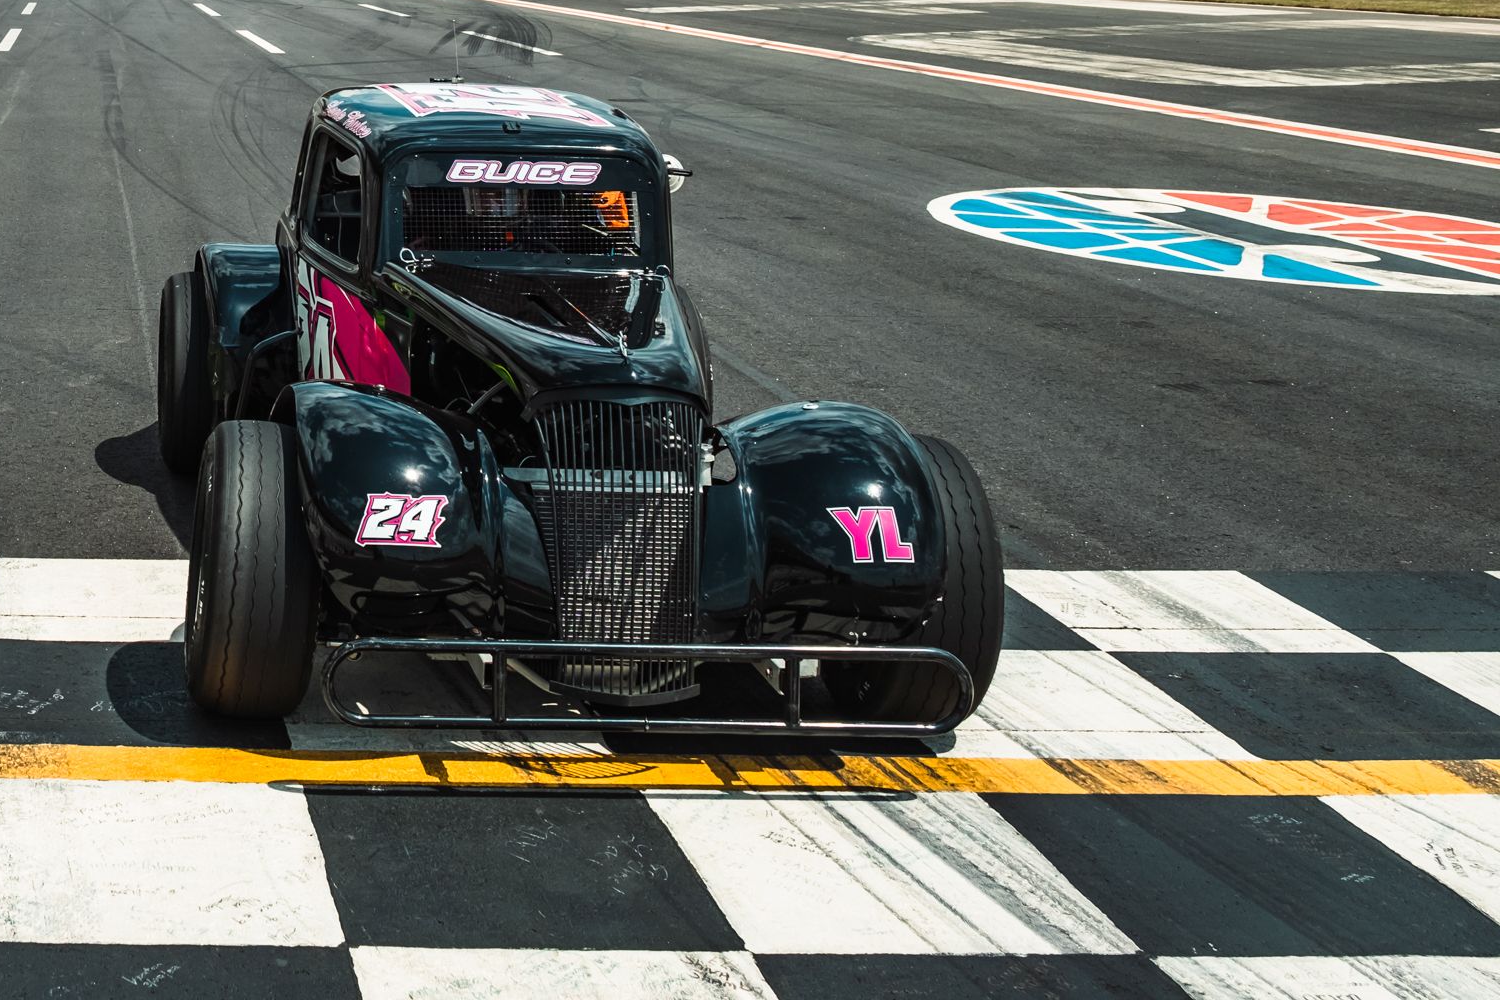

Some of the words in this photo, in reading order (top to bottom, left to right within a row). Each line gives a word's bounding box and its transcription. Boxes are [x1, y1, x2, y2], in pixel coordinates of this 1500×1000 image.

[446, 159, 602, 185] BUICE
[358, 494, 446, 546] 24
[827, 506, 915, 563] YL
